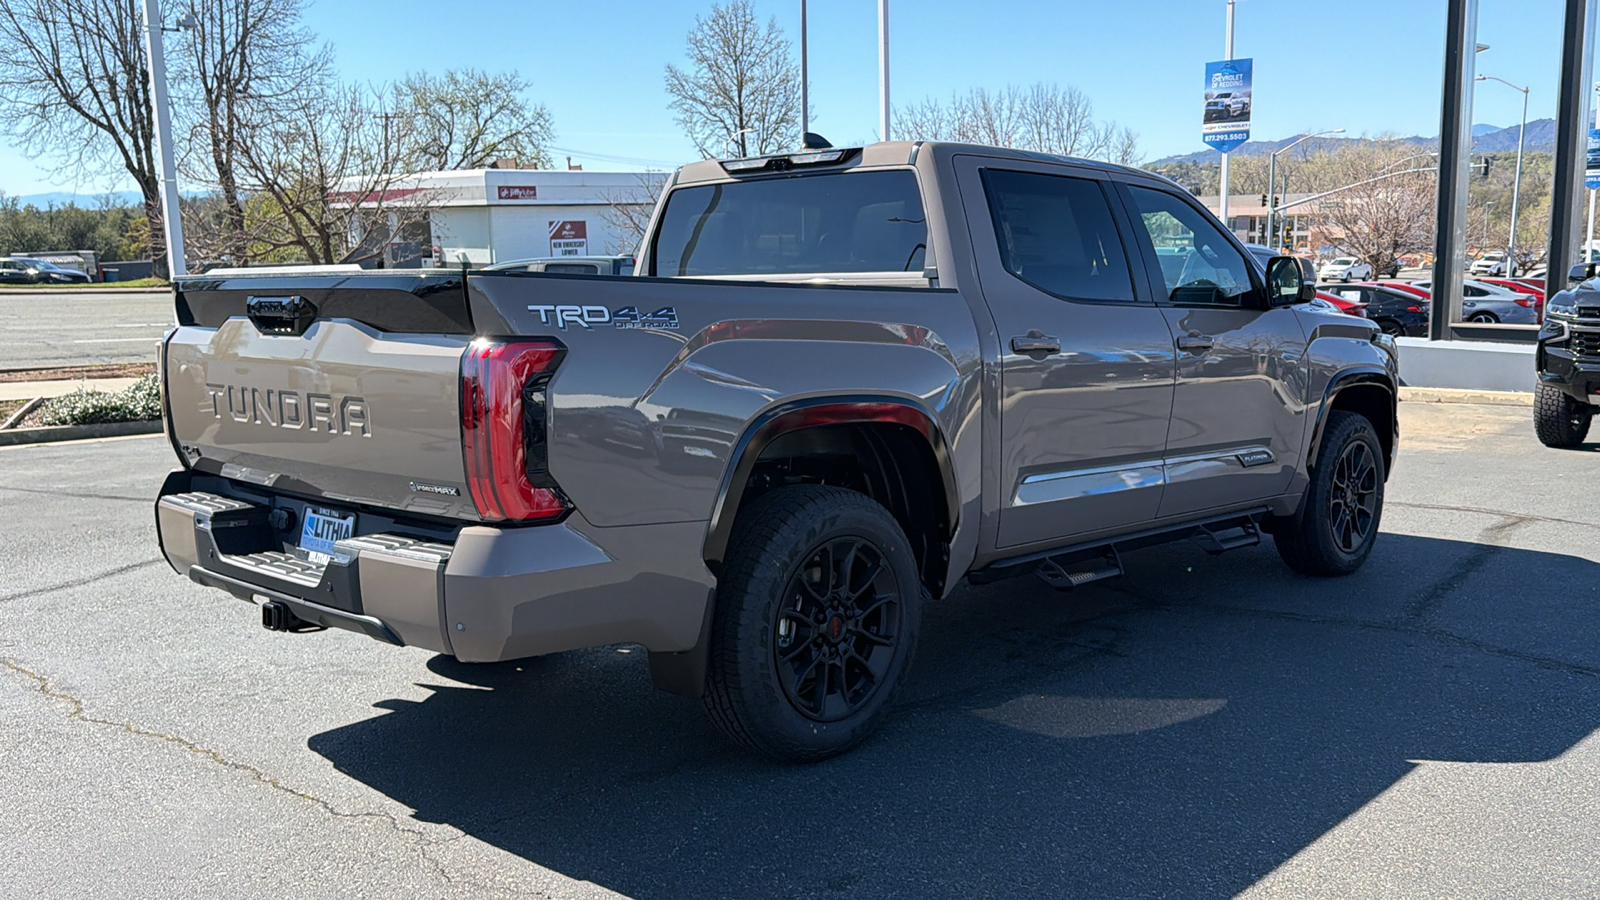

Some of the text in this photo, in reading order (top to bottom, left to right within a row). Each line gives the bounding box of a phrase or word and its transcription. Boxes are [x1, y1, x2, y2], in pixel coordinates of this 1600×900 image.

[1211, 74, 1243, 82] CHEVROLET
[1205, 133, 1247, 142] 877.293.5503
[527, 305, 612, 331] TRD
[205, 383, 372, 438] TUNDRA
[314, 517, 350, 542] LITHIA
